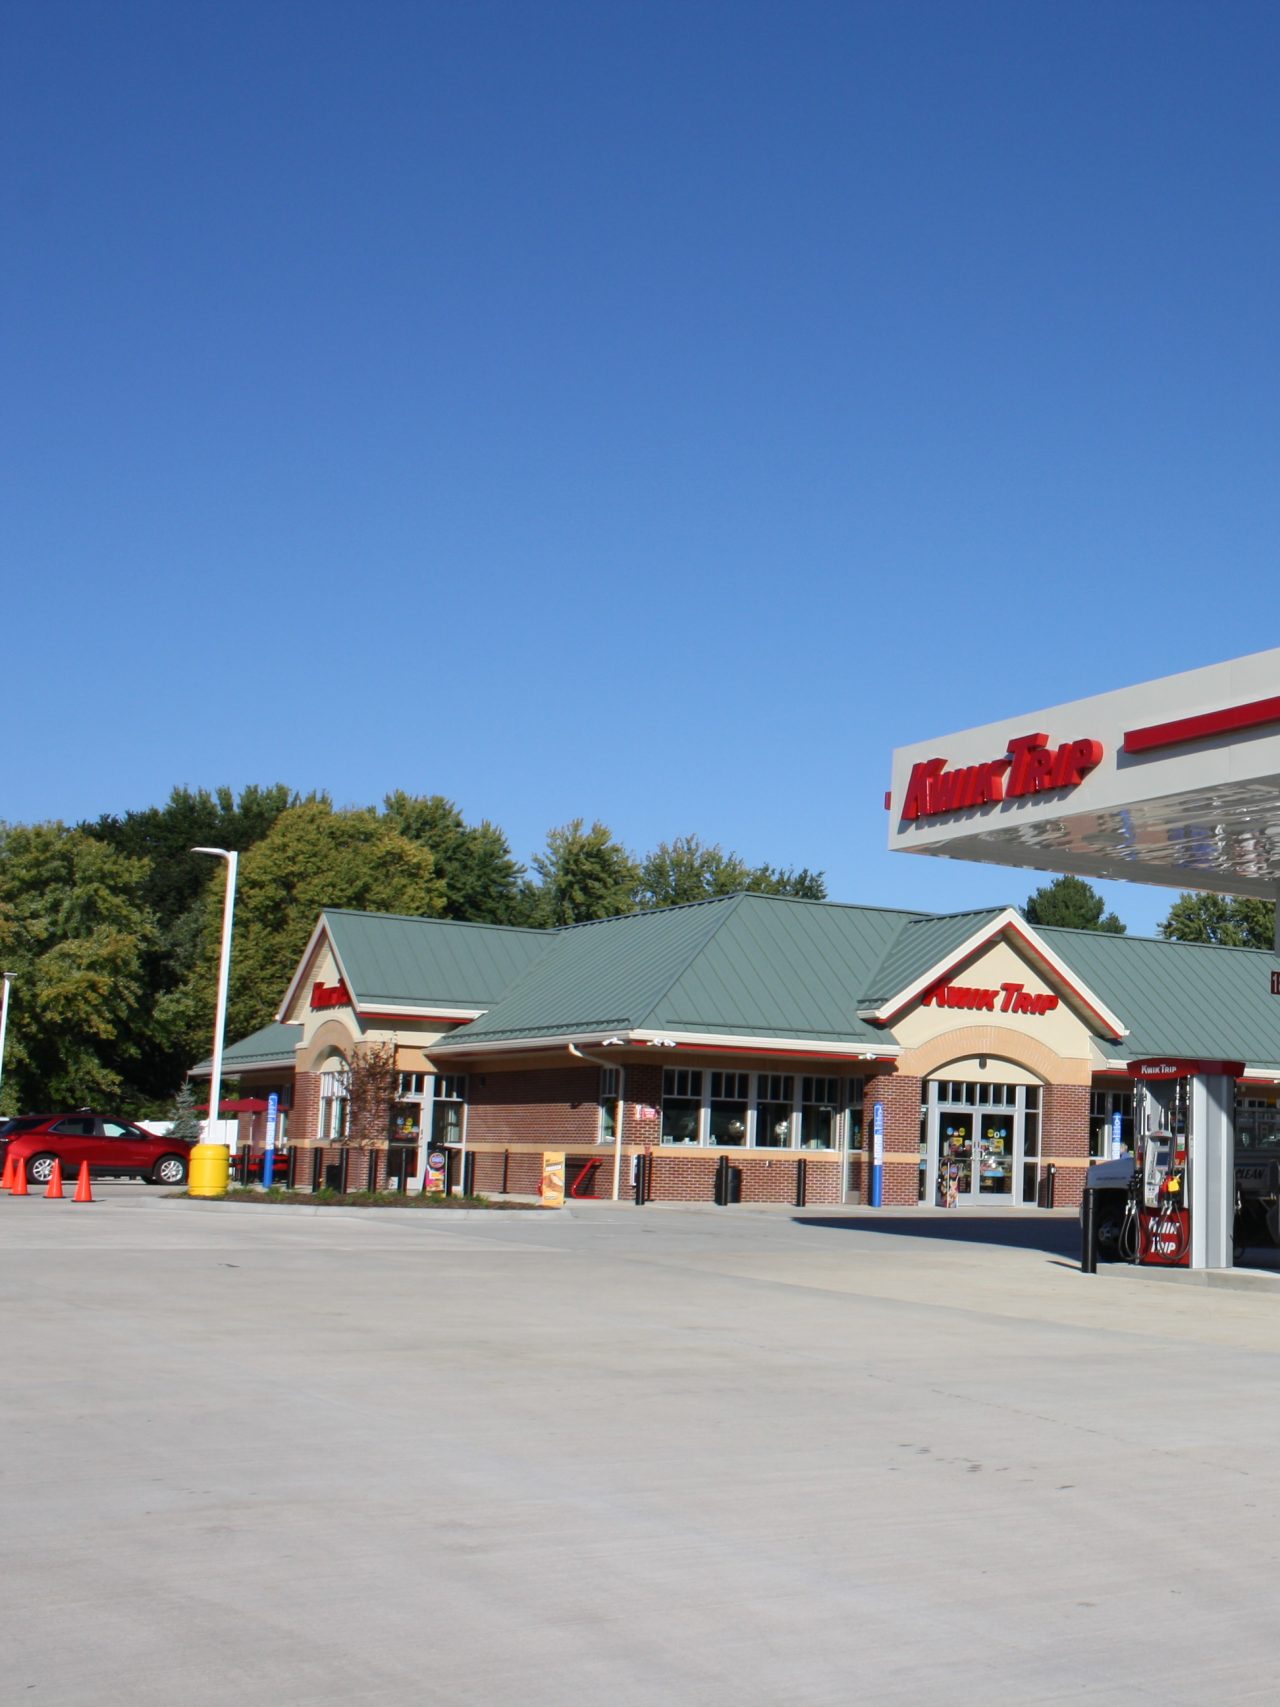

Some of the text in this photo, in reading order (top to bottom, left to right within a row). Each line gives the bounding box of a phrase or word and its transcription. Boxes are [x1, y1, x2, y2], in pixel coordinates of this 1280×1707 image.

[901, 733, 1103, 820] KWIK TRIP
[922, 978, 1059, 1015] KWIK TRIP
[1141, 1063, 1177, 1074] KWIK TRIP
